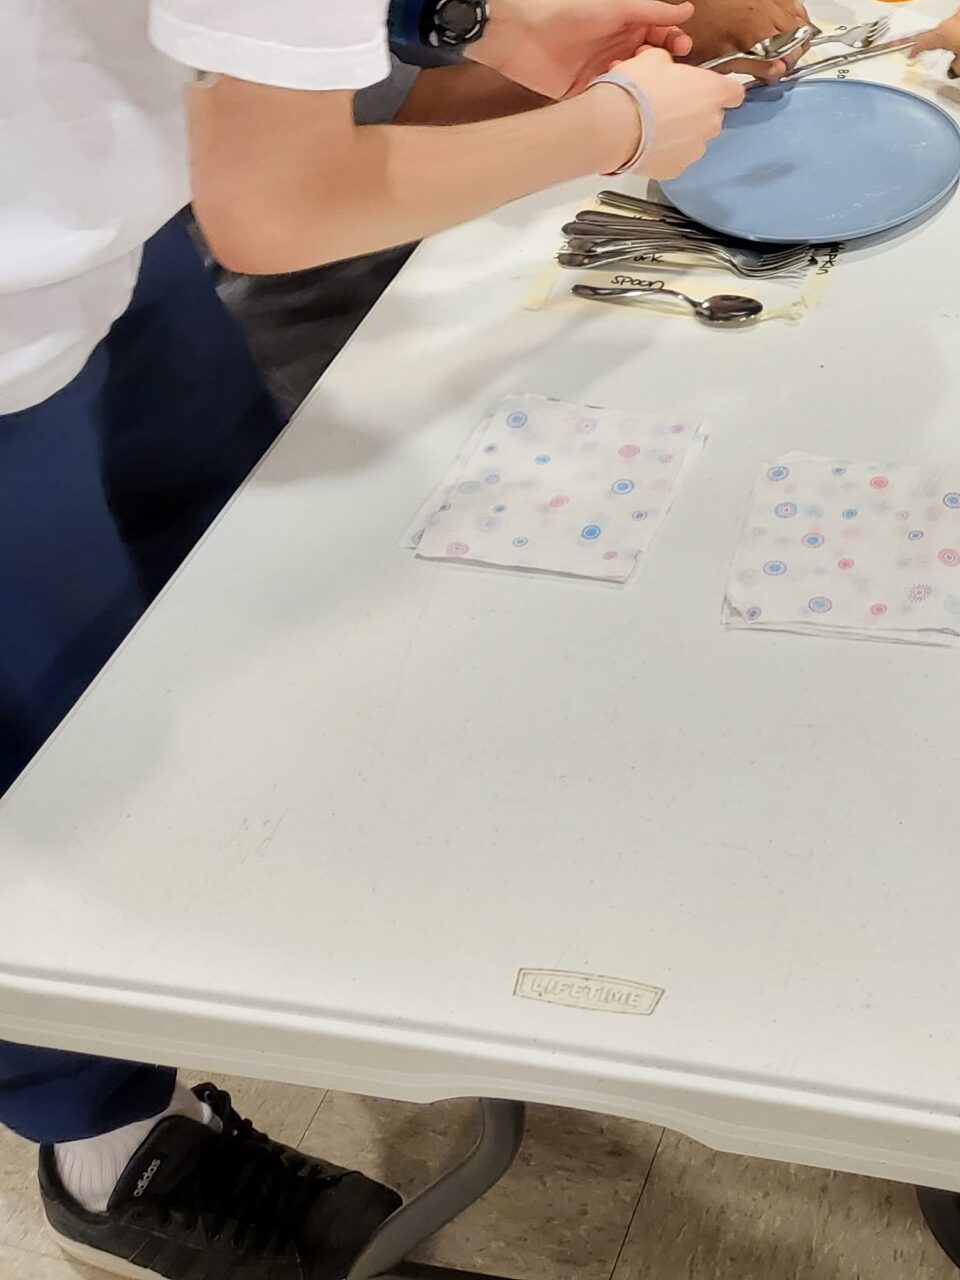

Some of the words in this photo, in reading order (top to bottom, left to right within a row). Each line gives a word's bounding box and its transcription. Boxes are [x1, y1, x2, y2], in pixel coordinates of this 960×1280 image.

[633, 252, 666, 263] ork
[529, 977, 644, 1008] LIFETIME
[133, 1158, 160, 1197] adidas
